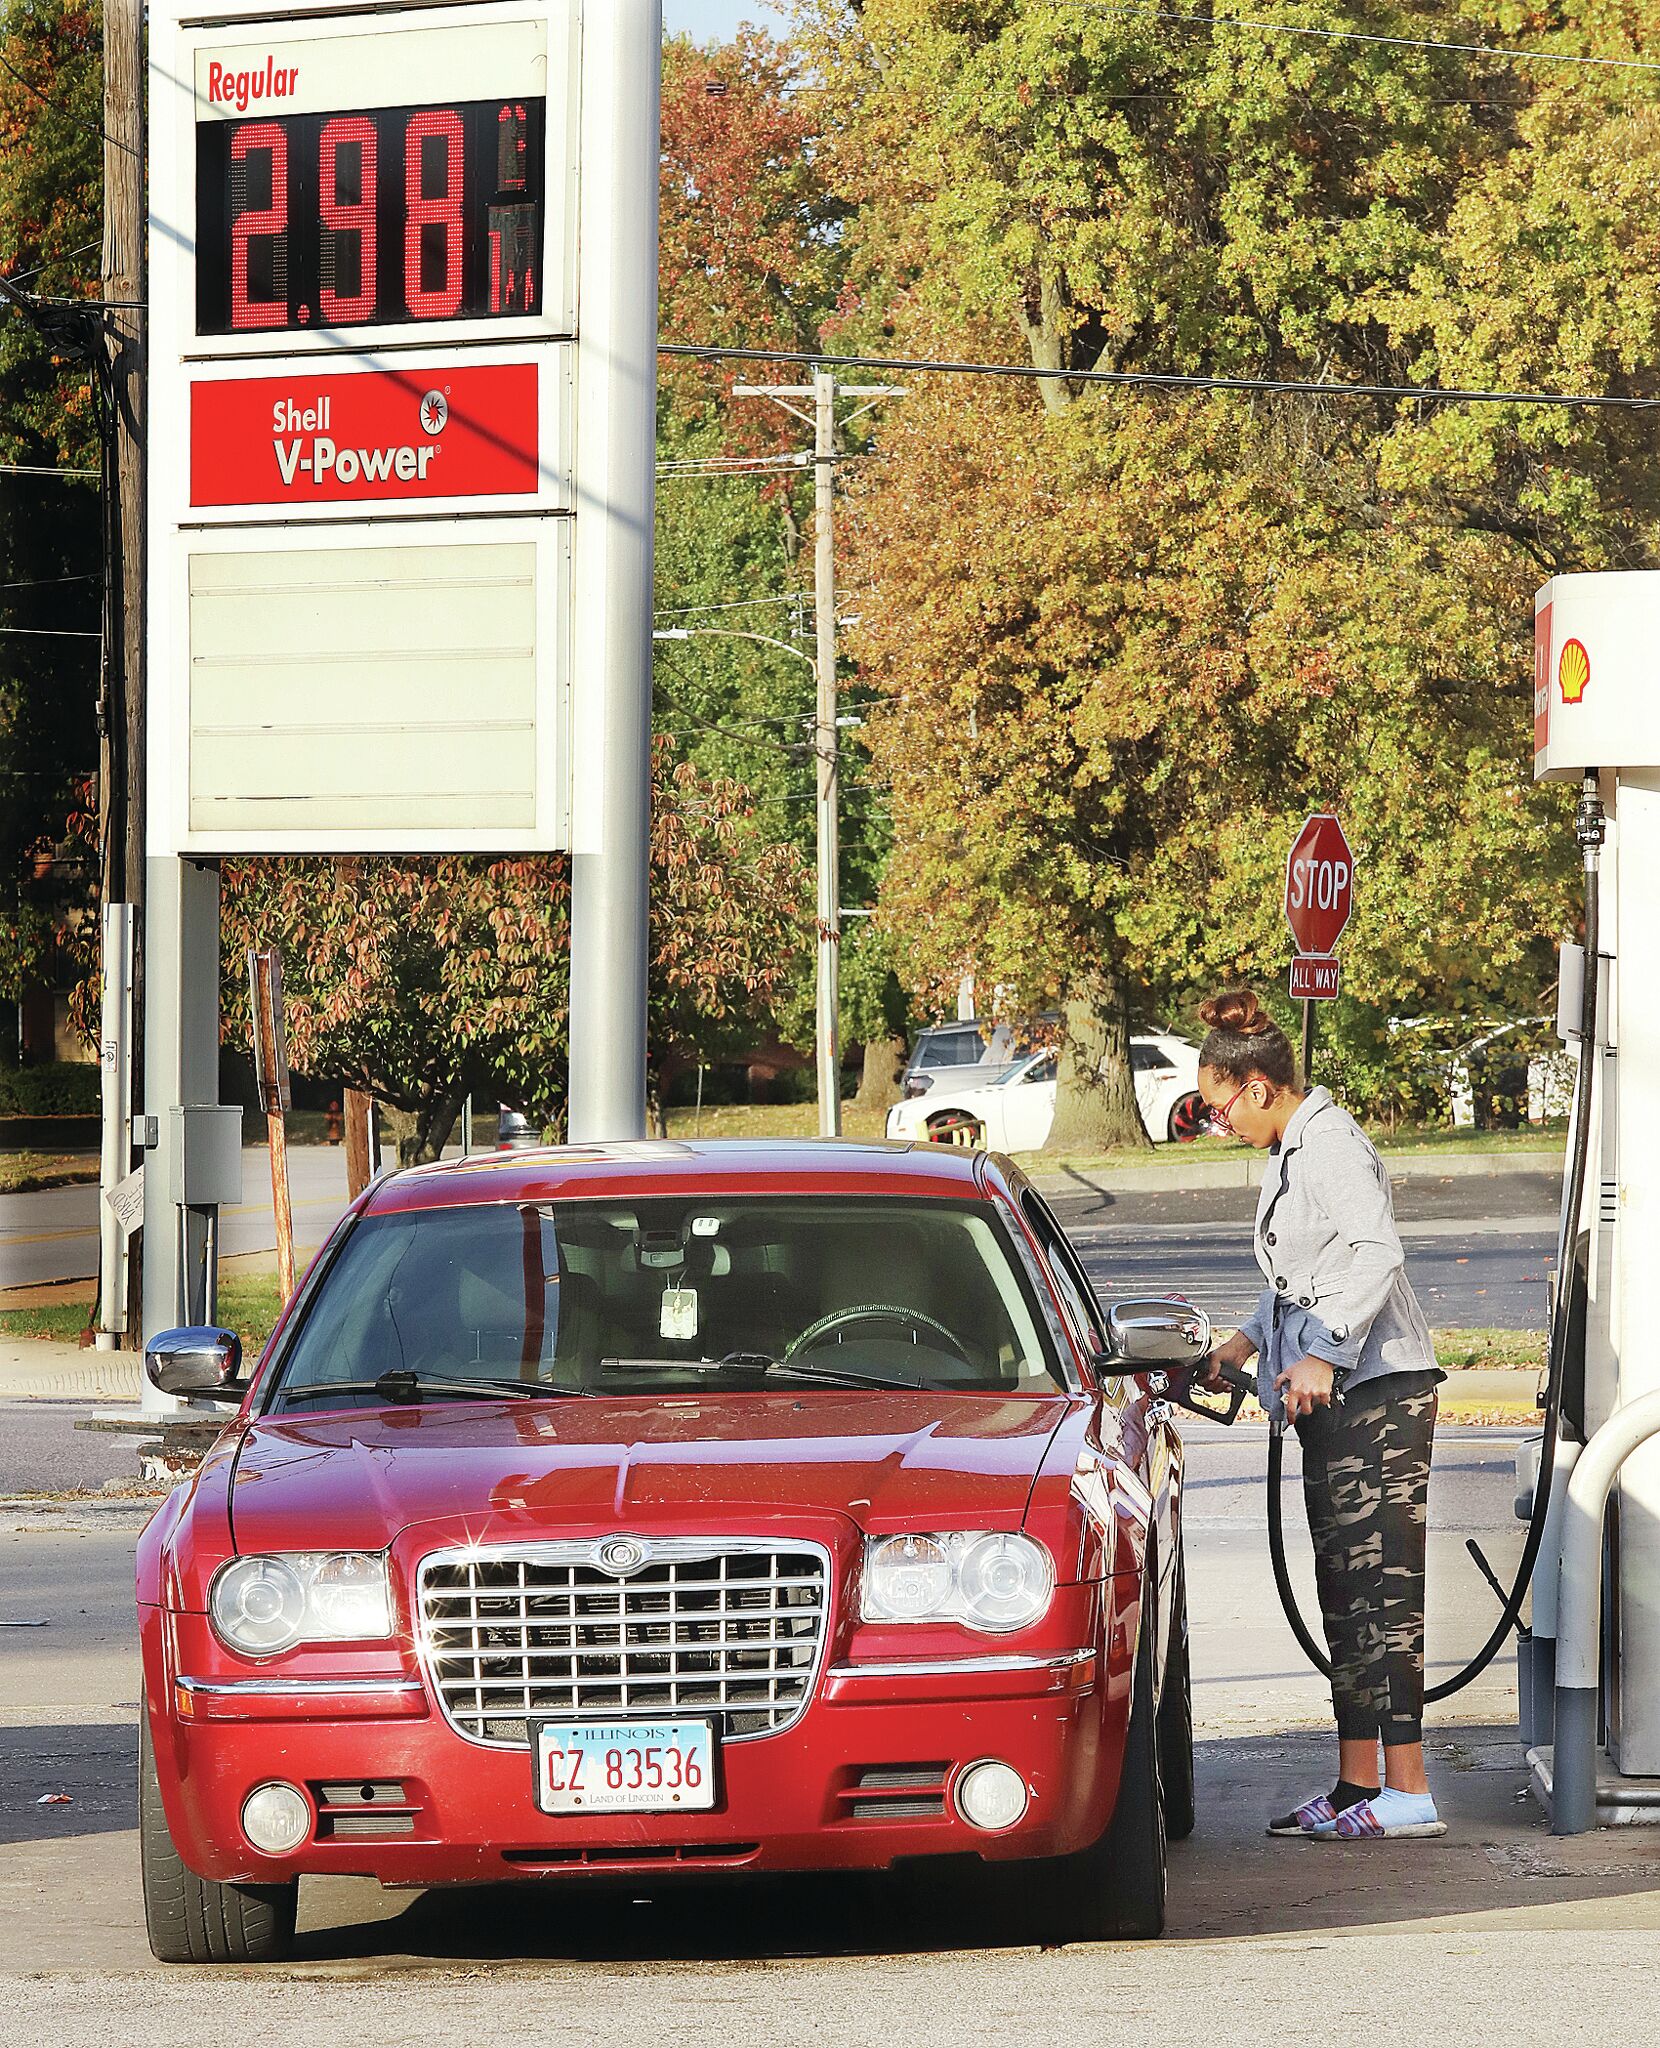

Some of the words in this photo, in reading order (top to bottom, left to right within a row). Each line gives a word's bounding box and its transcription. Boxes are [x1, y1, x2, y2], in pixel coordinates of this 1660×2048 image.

[209, 55, 298, 111] Regular
[272, 396, 330, 433] Shell
[273, 437, 434, 485] V-Power
[1290, 859, 1349, 910] STOP
[1292, 967, 1310, 988] ALL
[1315, 968, 1337, 989] WAY
[113, 1192, 136, 1225] YARD
[585, 1728, 665, 1741] ILLINOIS
[548, 1750, 585, 1791] CZ
[606, 1747, 701, 1789] 83536
[590, 1793, 614, 1804] LAND
[615, 1794, 627, 1803] OF
[628, 1792, 664, 1803] LINCOLN
